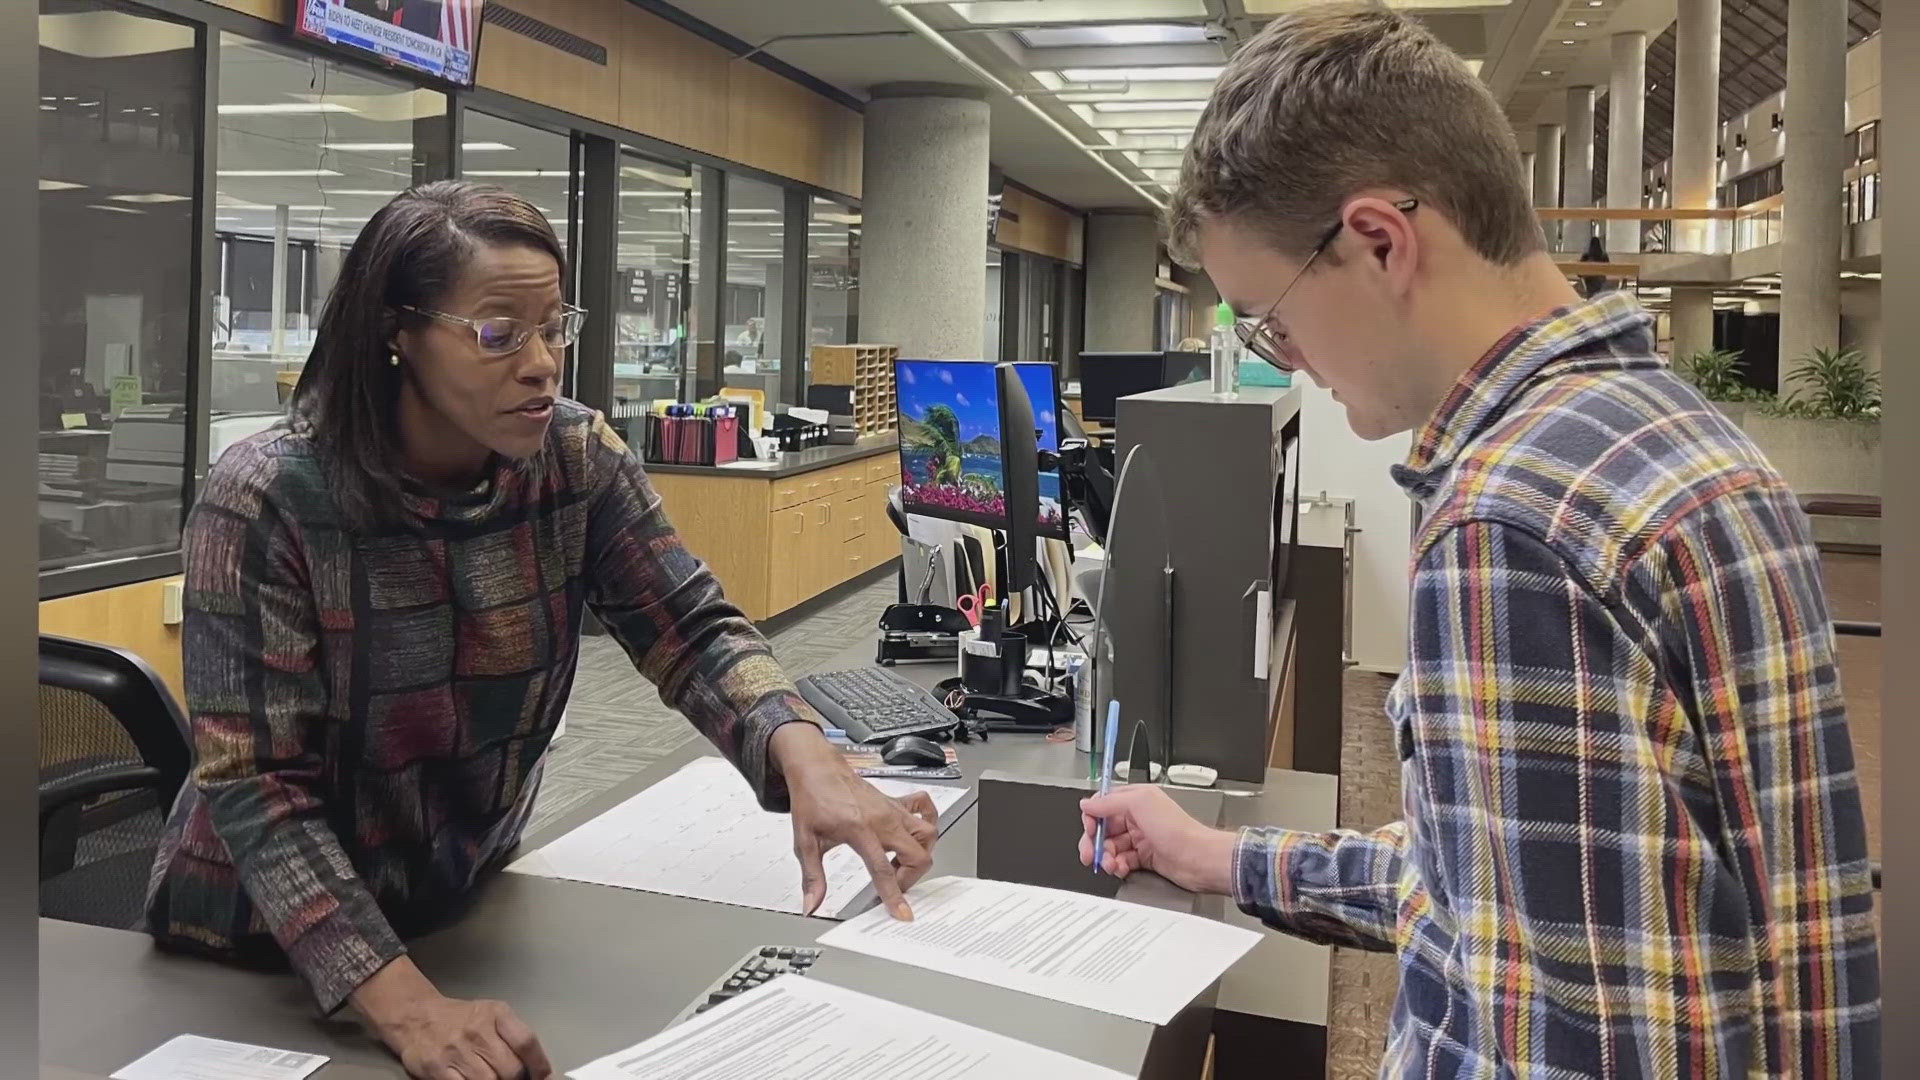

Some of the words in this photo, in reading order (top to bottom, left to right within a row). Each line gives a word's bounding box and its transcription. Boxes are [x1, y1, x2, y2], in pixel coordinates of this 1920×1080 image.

[328, 8, 343, 24] BIDEN
[350, 16, 363, 29] MEET
[363, 21, 382, 37] CHINESE
[382, 27, 405, 43] PRESIDENT
[405, 34, 430, 52] TOMORROW
